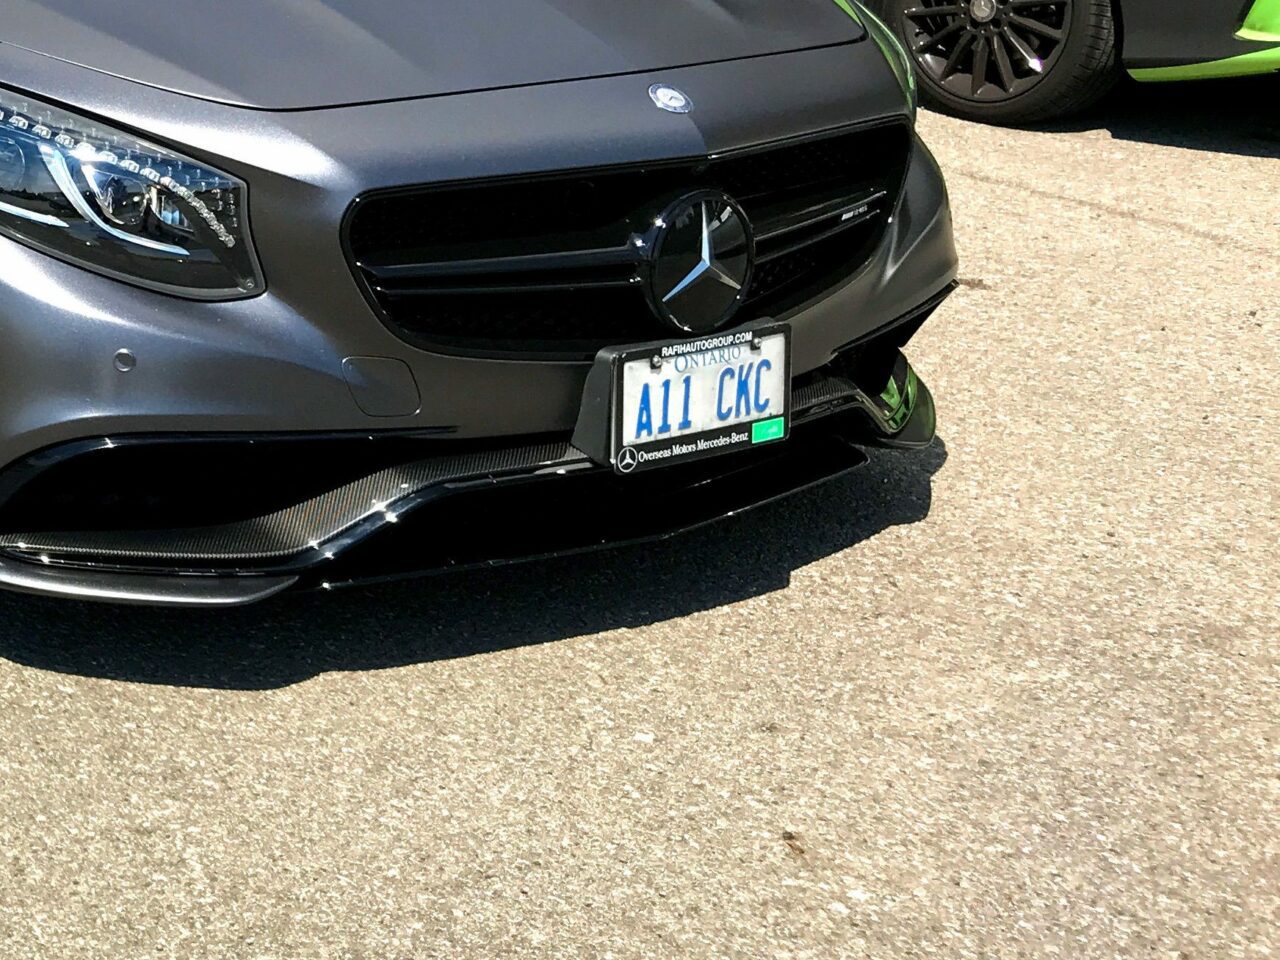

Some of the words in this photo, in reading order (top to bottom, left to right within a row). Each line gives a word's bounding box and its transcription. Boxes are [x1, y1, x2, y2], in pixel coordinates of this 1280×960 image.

[661, 331, 753, 357] RAFIHAUTOGROUP.COM
[674, 346, 742, 373] ONTARIO
[716, 359, 772, 421] CKC
[638, 446, 671, 462] Overseas
[672, 441, 696, 456] Motors
[697, 431, 749, 451] Mercedes-Benz
